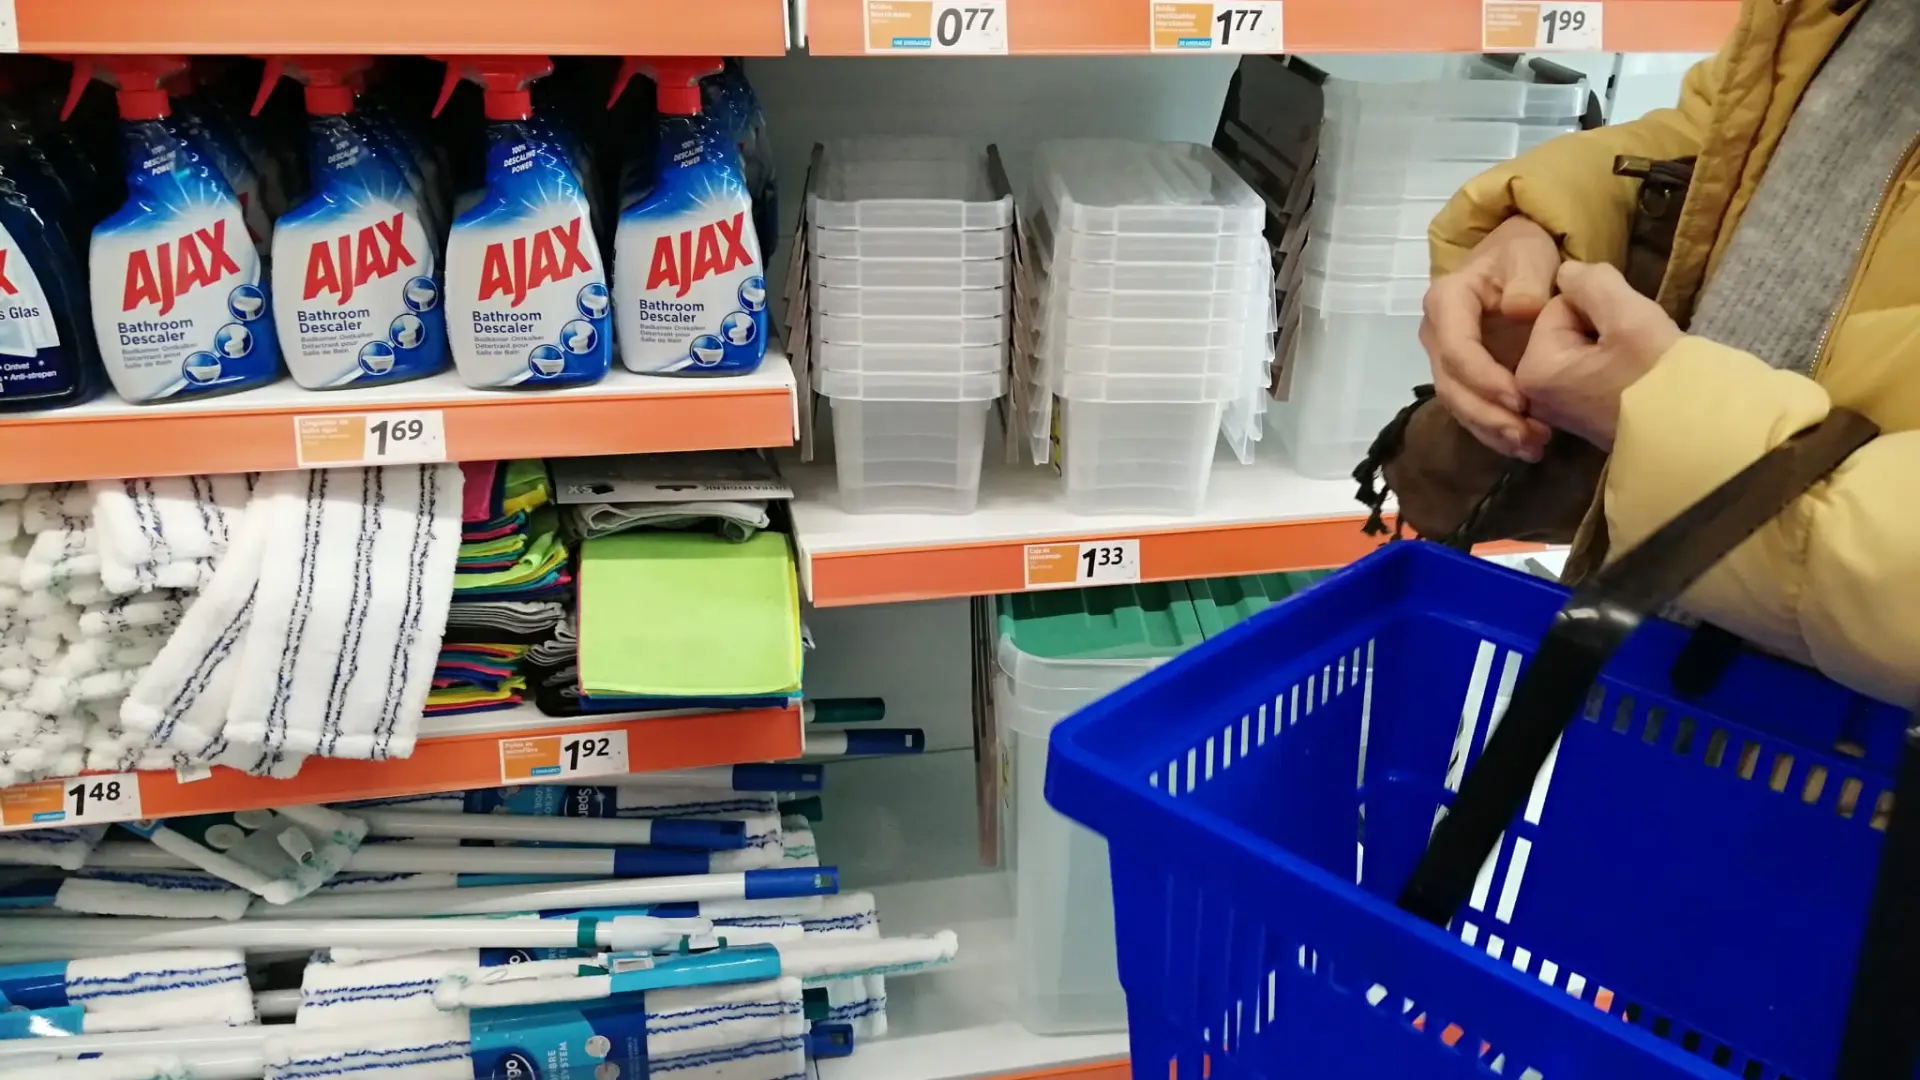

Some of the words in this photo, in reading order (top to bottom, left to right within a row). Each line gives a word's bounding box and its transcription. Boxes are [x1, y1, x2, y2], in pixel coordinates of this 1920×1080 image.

[143, 150, 176, 169] DESCALING
[503, 149, 536, 167] DESCALING
[674, 145, 704, 161] DESCALING
[512, 160, 533, 174] POWER
[303, 211, 417, 306] AJAX
[478, 216, 593, 308] AJAX
[645, 211, 754, 299] AJAX
[122, 218, 241, 317] AJAX
[9, 306, 40, 319] Glas
[639, 299, 705, 312] Bathroom
[297, 309, 370, 321] Bathroom
[472, 311, 542, 322] Bathroom
[640, 310, 697, 323] Descaler
[117, 319, 194, 334] Bathroom
[299, 320, 362, 333] Descaler
[474, 322, 534, 333] Descaler
[120, 331, 185, 346] Descaler
[576, 788, 592, 817] Spar
